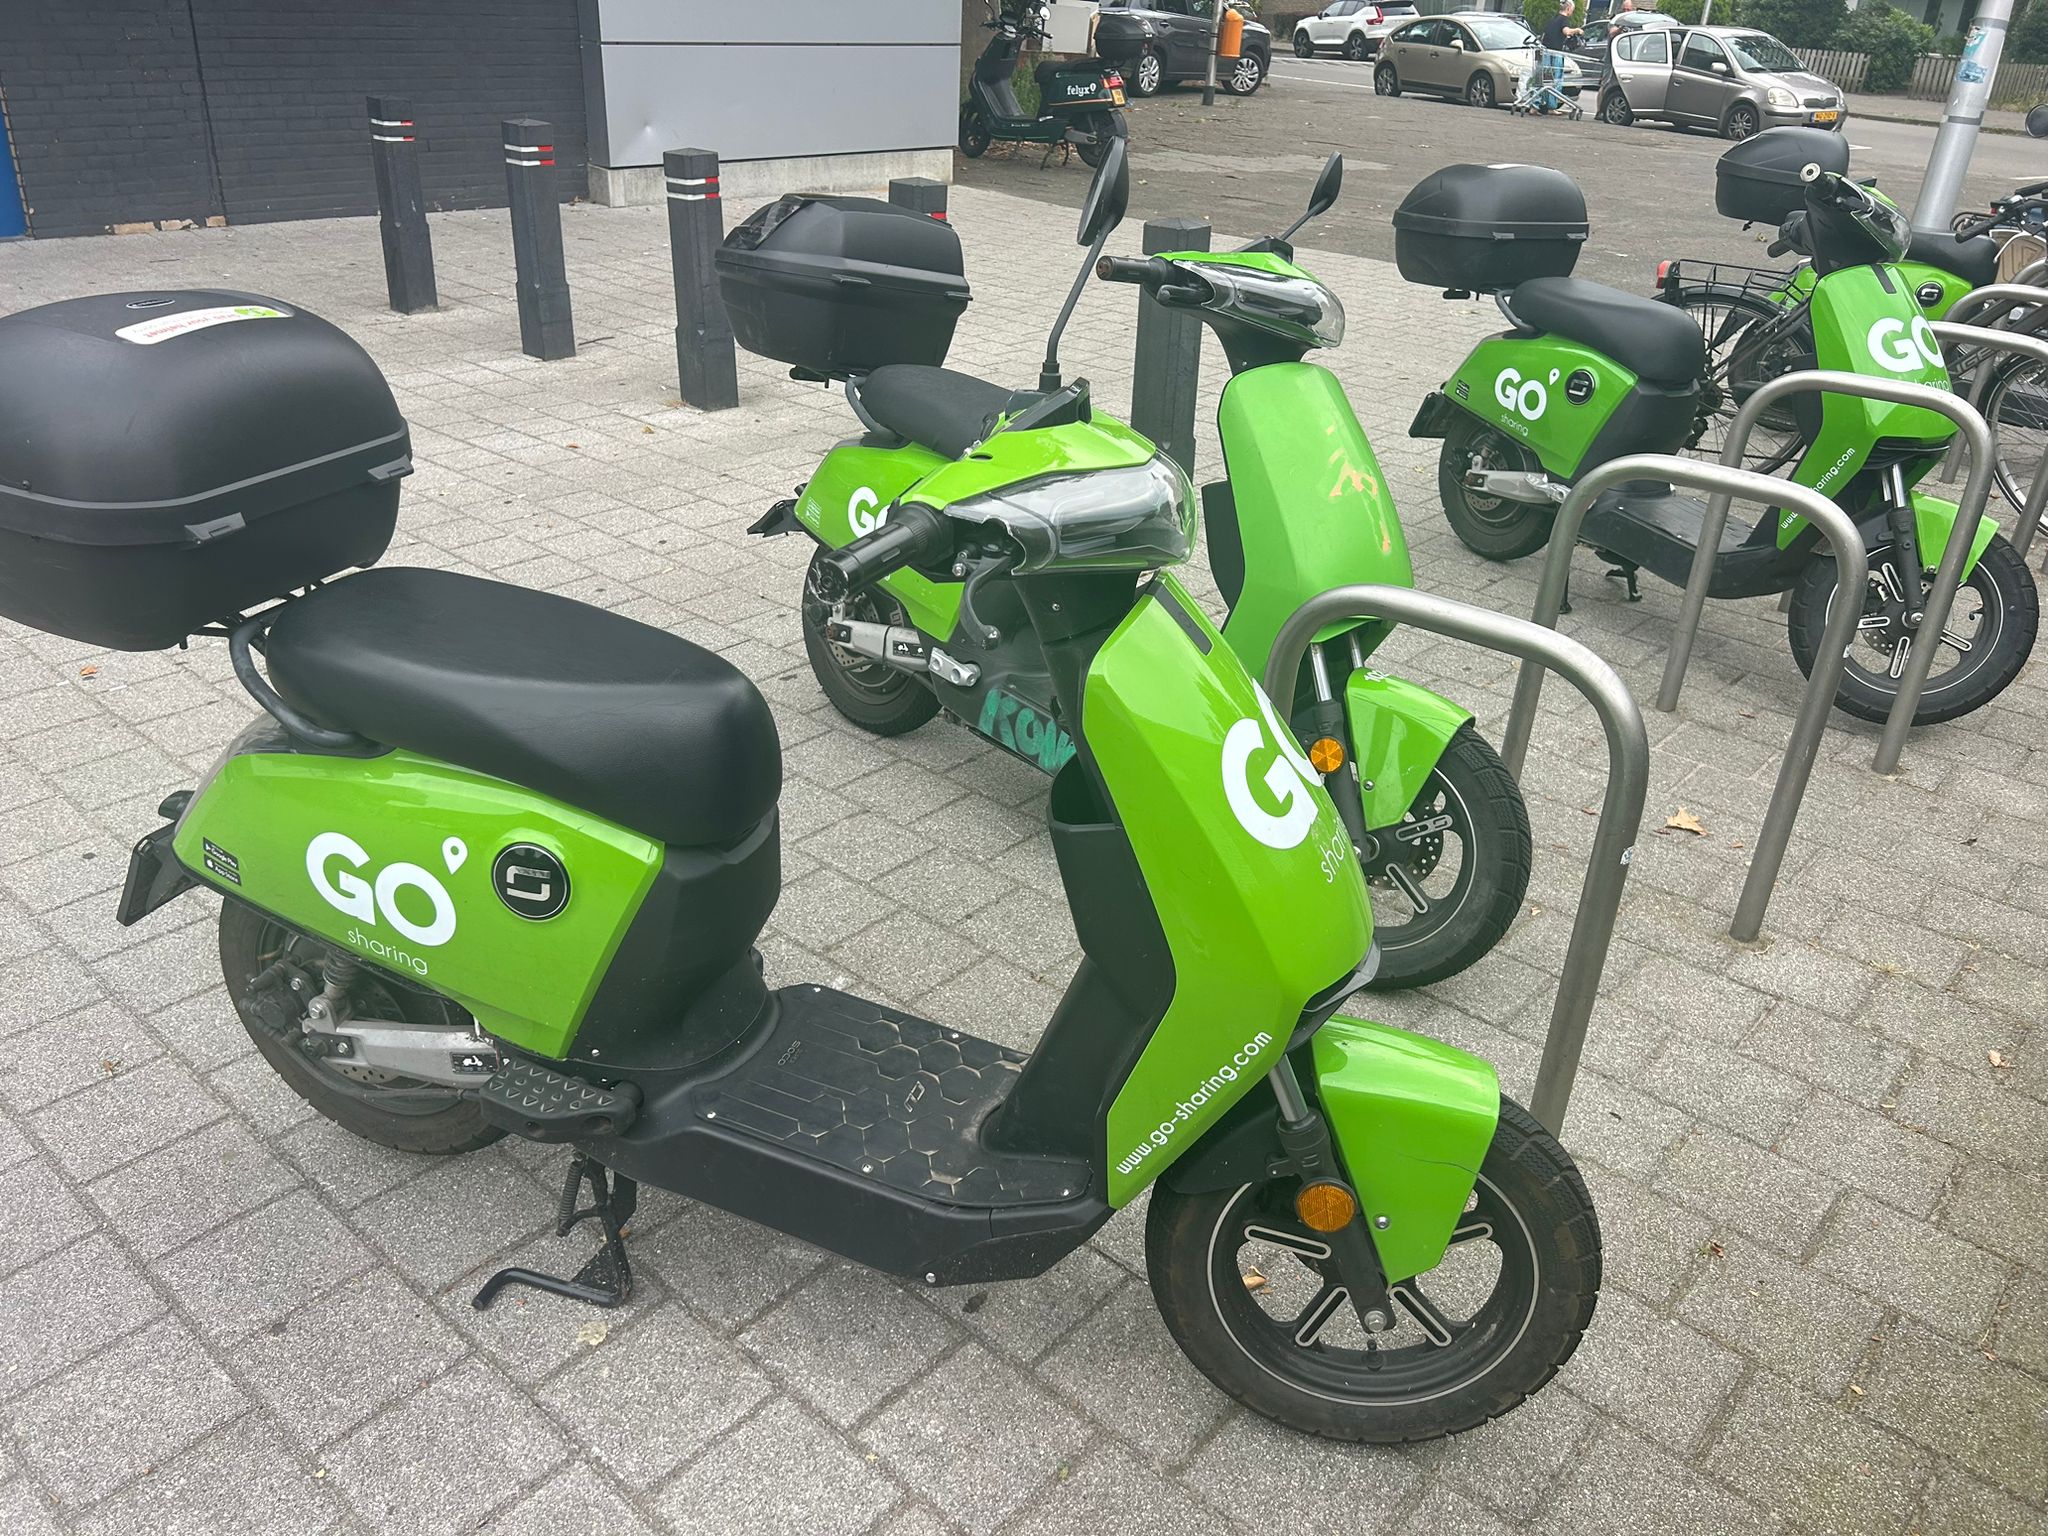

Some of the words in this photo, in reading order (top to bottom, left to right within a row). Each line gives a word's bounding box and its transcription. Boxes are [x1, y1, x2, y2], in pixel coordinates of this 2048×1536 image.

[1067, 84, 1090, 97] felyx
[1866, 315, 1946, 373] GO
[1494, 367, 1547, 421] GO
[1500, 413, 1529, 437] sharing
[305, 831, 457, 947] GO
[348, 927, 429, 976] sharing
[1116, 1031, 1273, 1175] www.go-sharing.com
